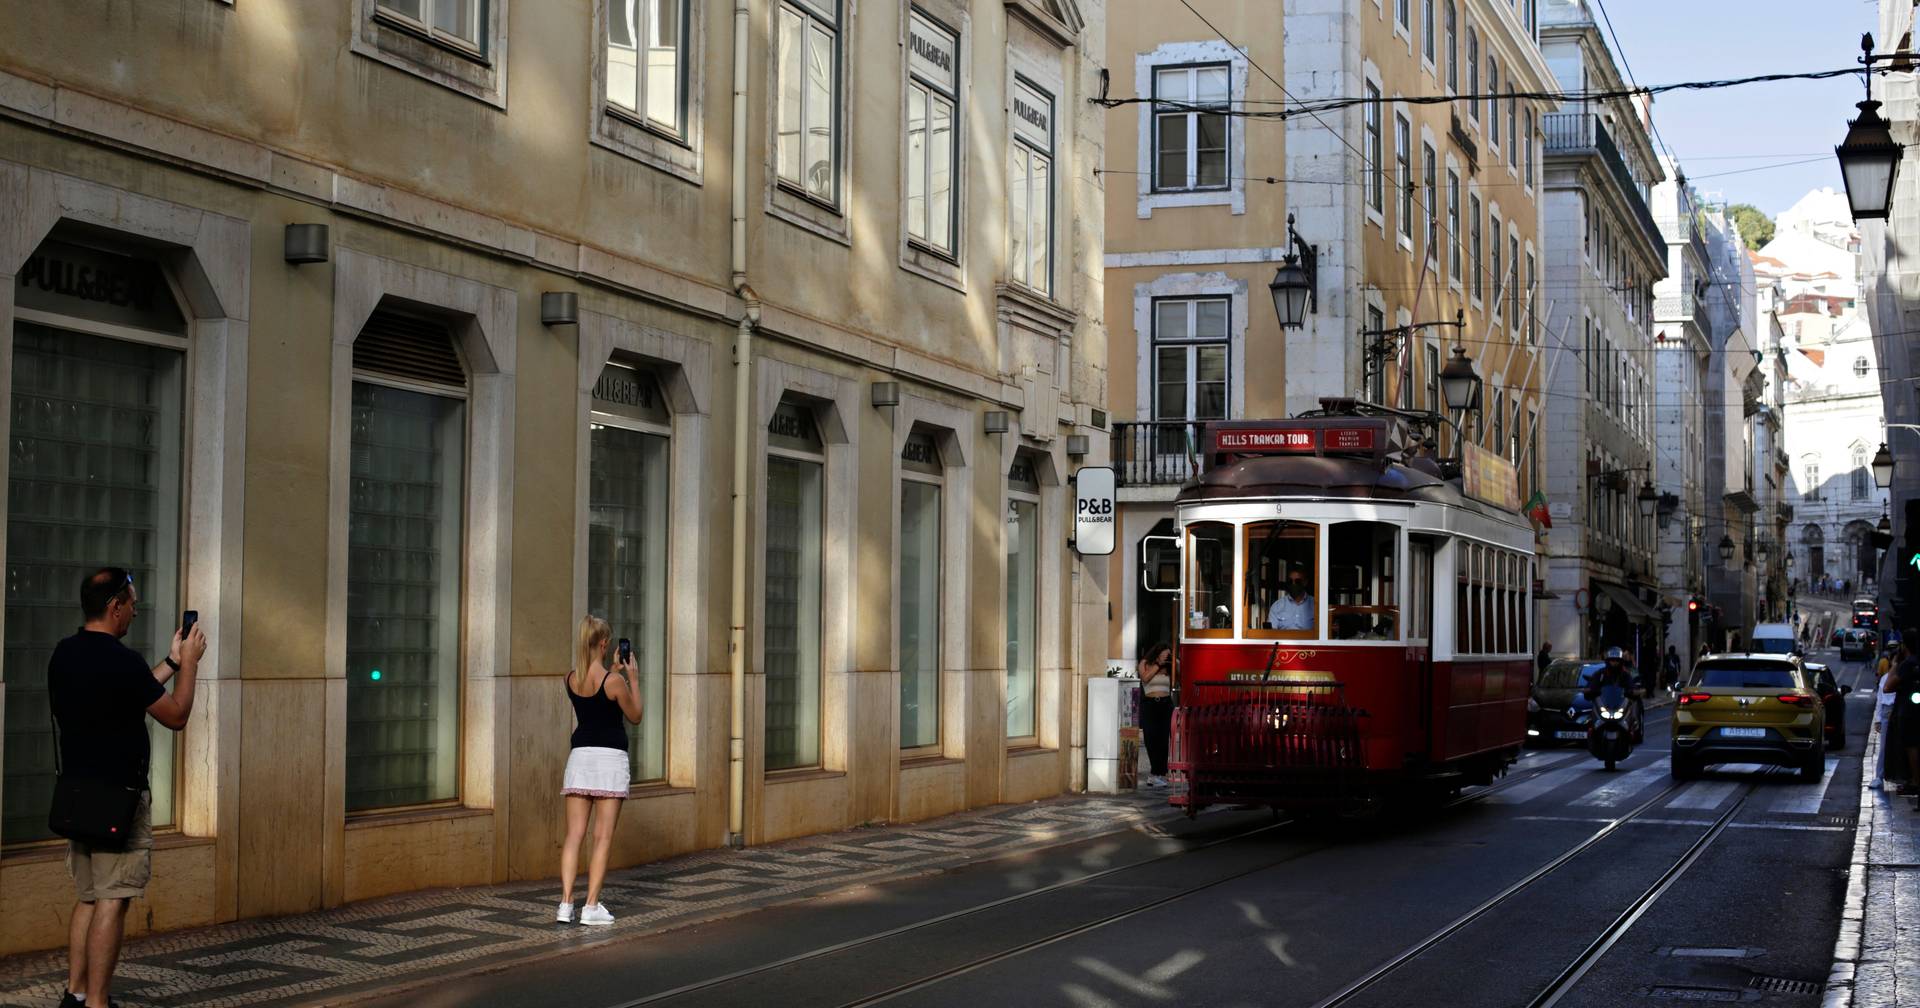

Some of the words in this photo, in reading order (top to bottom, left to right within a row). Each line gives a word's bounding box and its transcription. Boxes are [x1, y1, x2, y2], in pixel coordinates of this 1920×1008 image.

[910, 31, 951, 73] PULL&BEAR
[1014, 97, 1047, 132] PULL&BEAR
[1222, 434, 1247, 446] HILLS
[1249, 434, 1285, 446] TRAMCAR
[1287, 433, 1309, 445] TOUR
[1078, 498, 1112, 515] P&B
